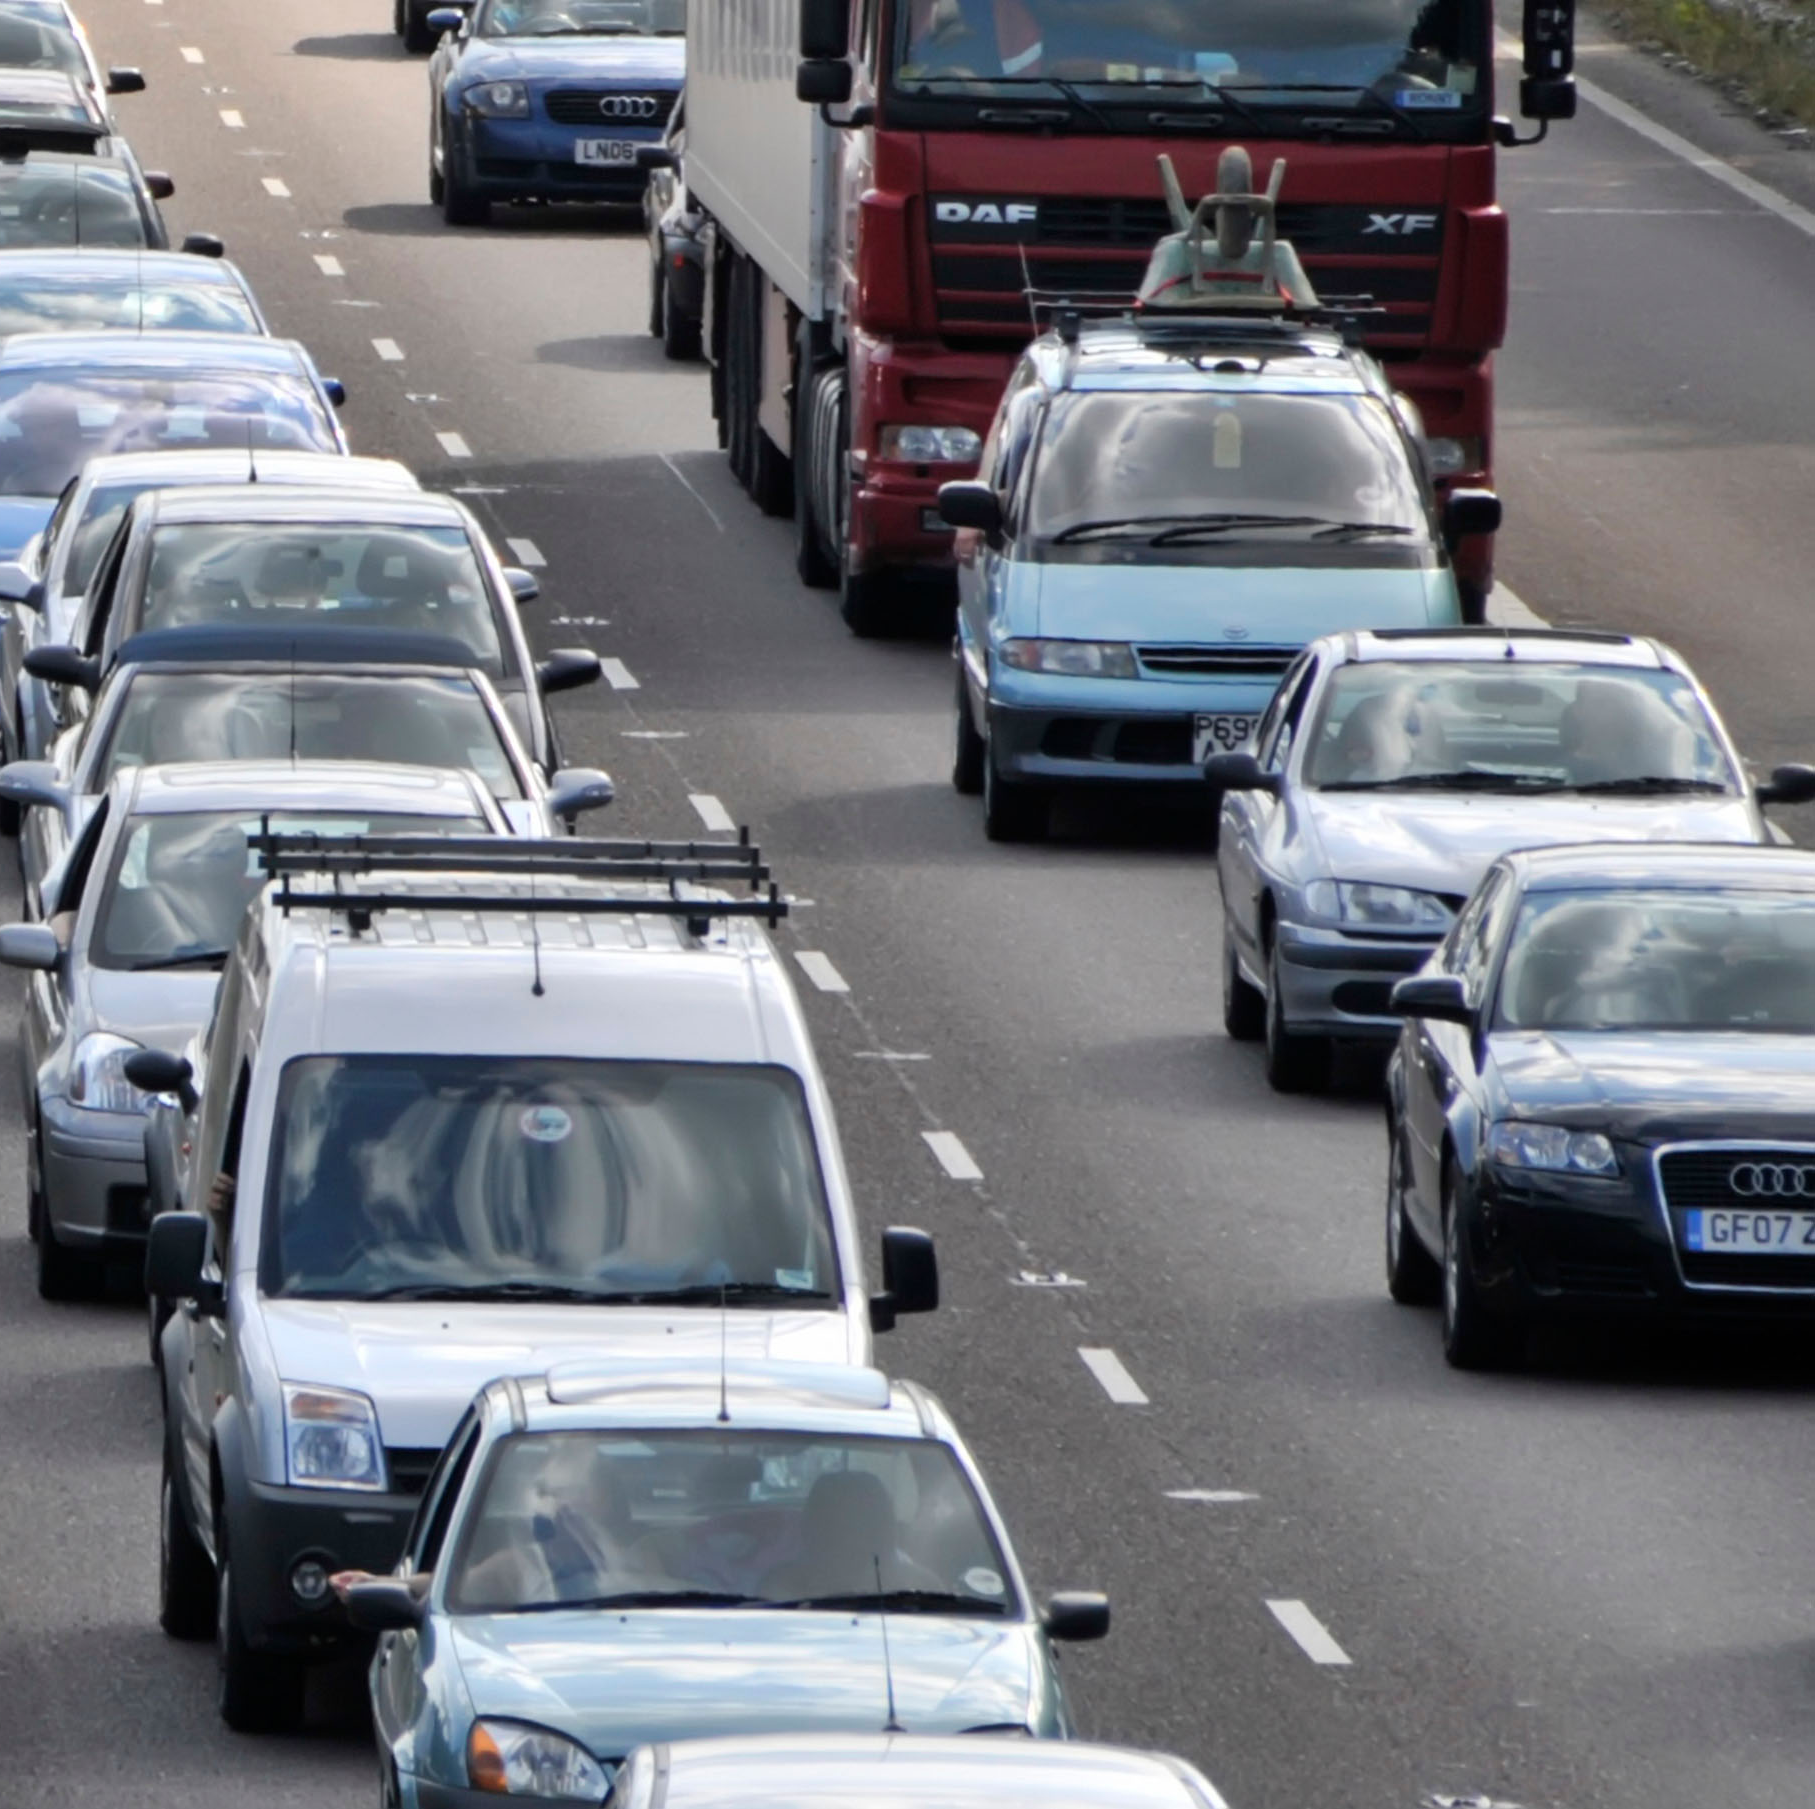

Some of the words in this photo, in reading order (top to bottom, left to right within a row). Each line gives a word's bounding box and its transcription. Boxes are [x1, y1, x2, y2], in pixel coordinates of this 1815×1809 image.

[935, 202, 1038, 224] DAF
[1361, 213, 1438, 234] XF
[1710, 1213, 1793, 1244] GF07
